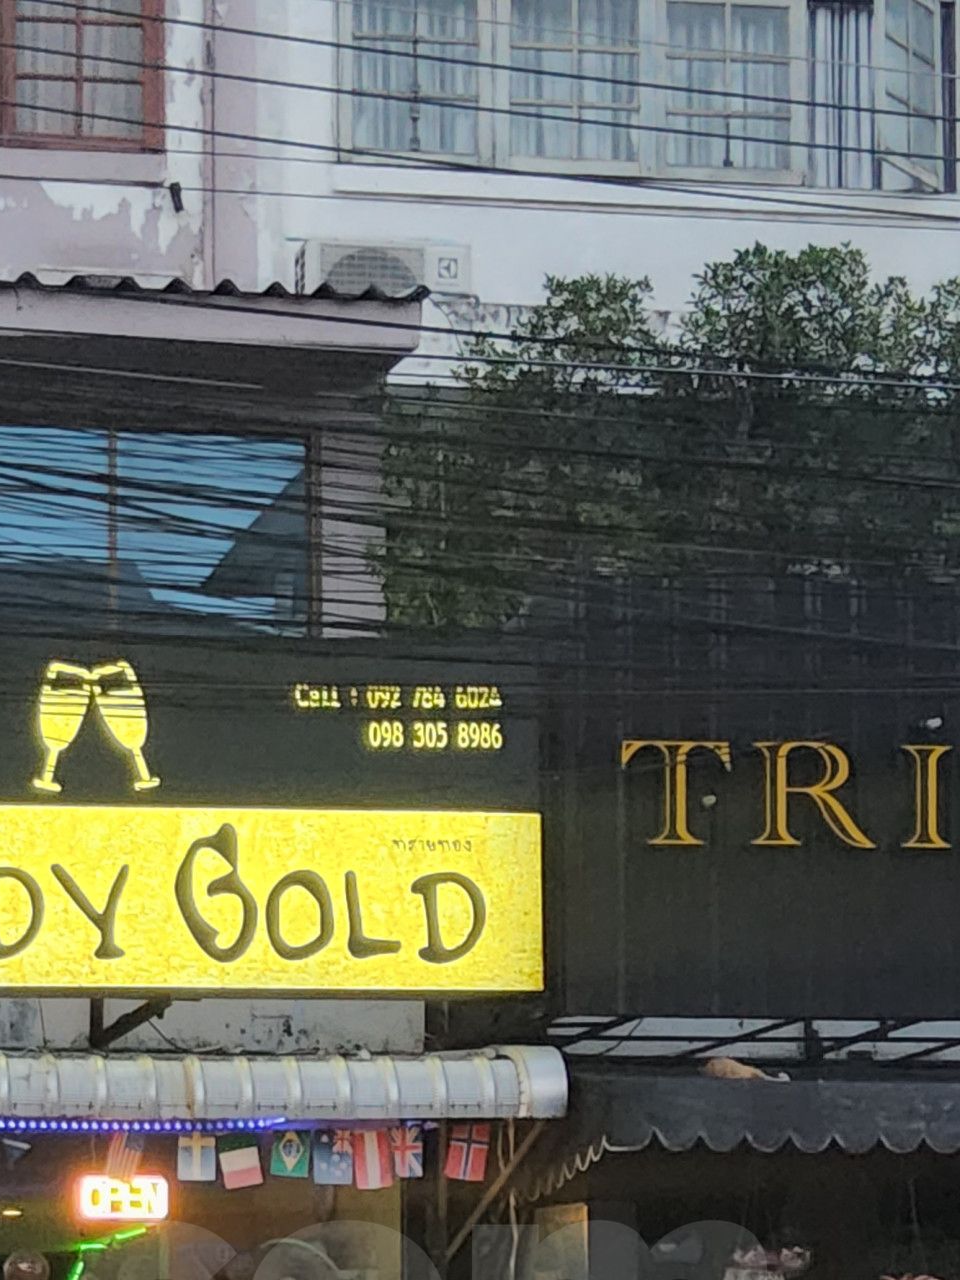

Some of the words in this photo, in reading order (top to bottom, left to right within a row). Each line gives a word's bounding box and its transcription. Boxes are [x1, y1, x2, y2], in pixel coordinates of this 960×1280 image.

[368, 720, 405, 748] 098
[413, 721, 448, 748] 305
[457, 721, 503, 749] 8986
[621, 740, 952, 850] TRI
[174, 822, 487, 963] GOLD
[83, 1179, 164, 1216] OPEN
